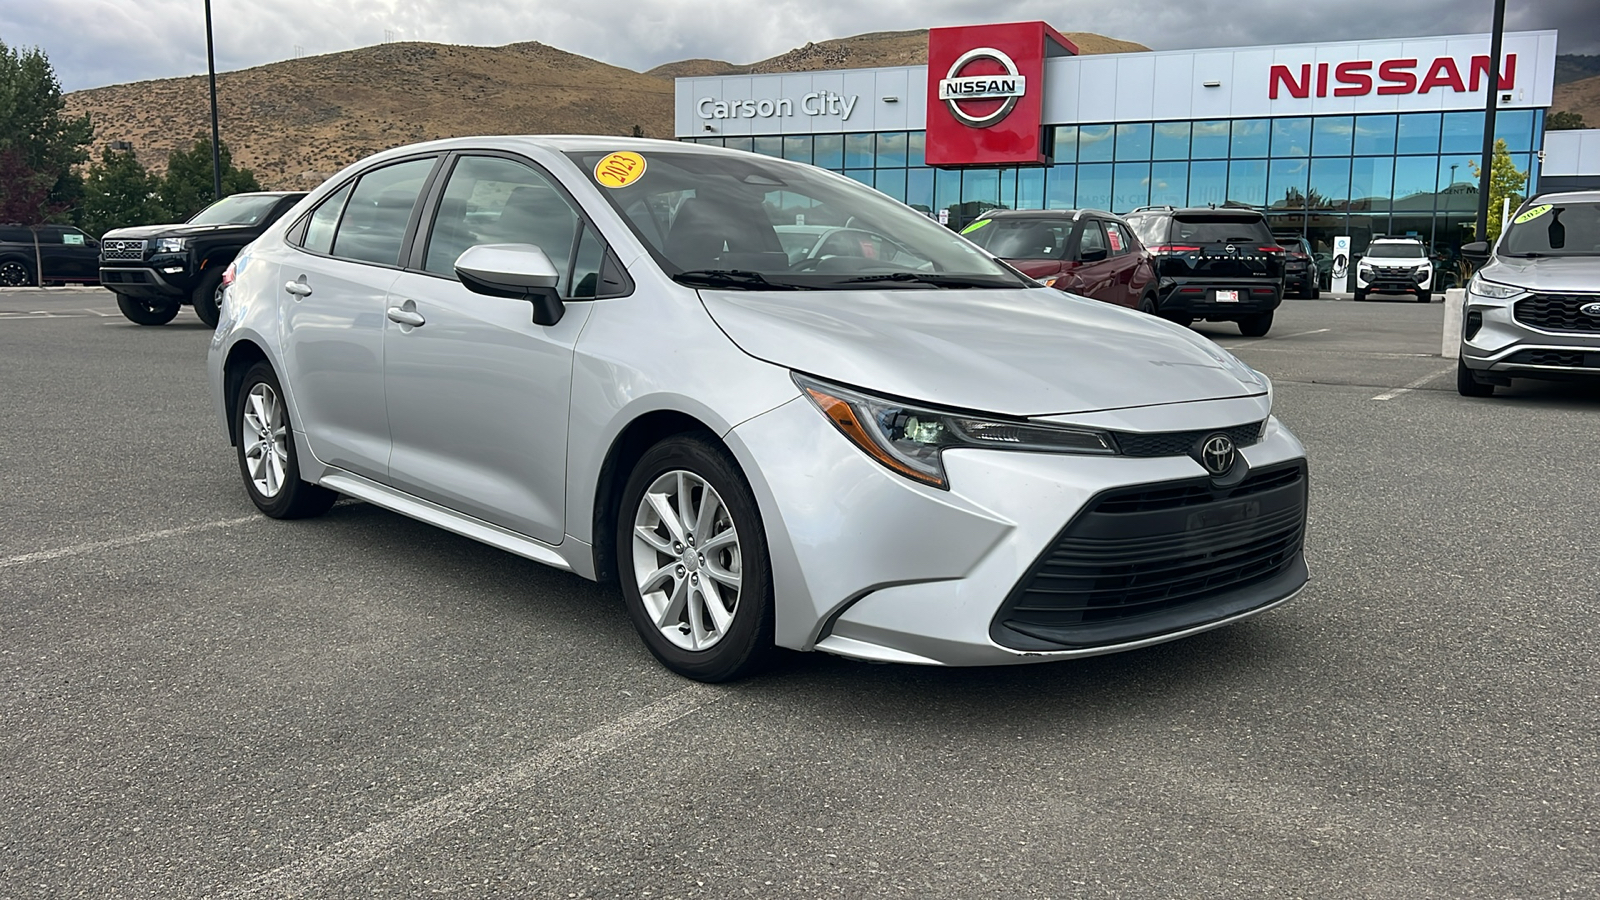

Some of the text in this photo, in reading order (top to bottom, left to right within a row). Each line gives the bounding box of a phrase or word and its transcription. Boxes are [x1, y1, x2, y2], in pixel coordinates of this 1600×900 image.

[946, 80, 1016, 95] NISSAN
[1268, 53, 1517, 100] NISSAN
[696, 90, 858, 121] Carson City
[601, 154, 637, 184] 2023
[1522, 206, 1546, 221] 2024
